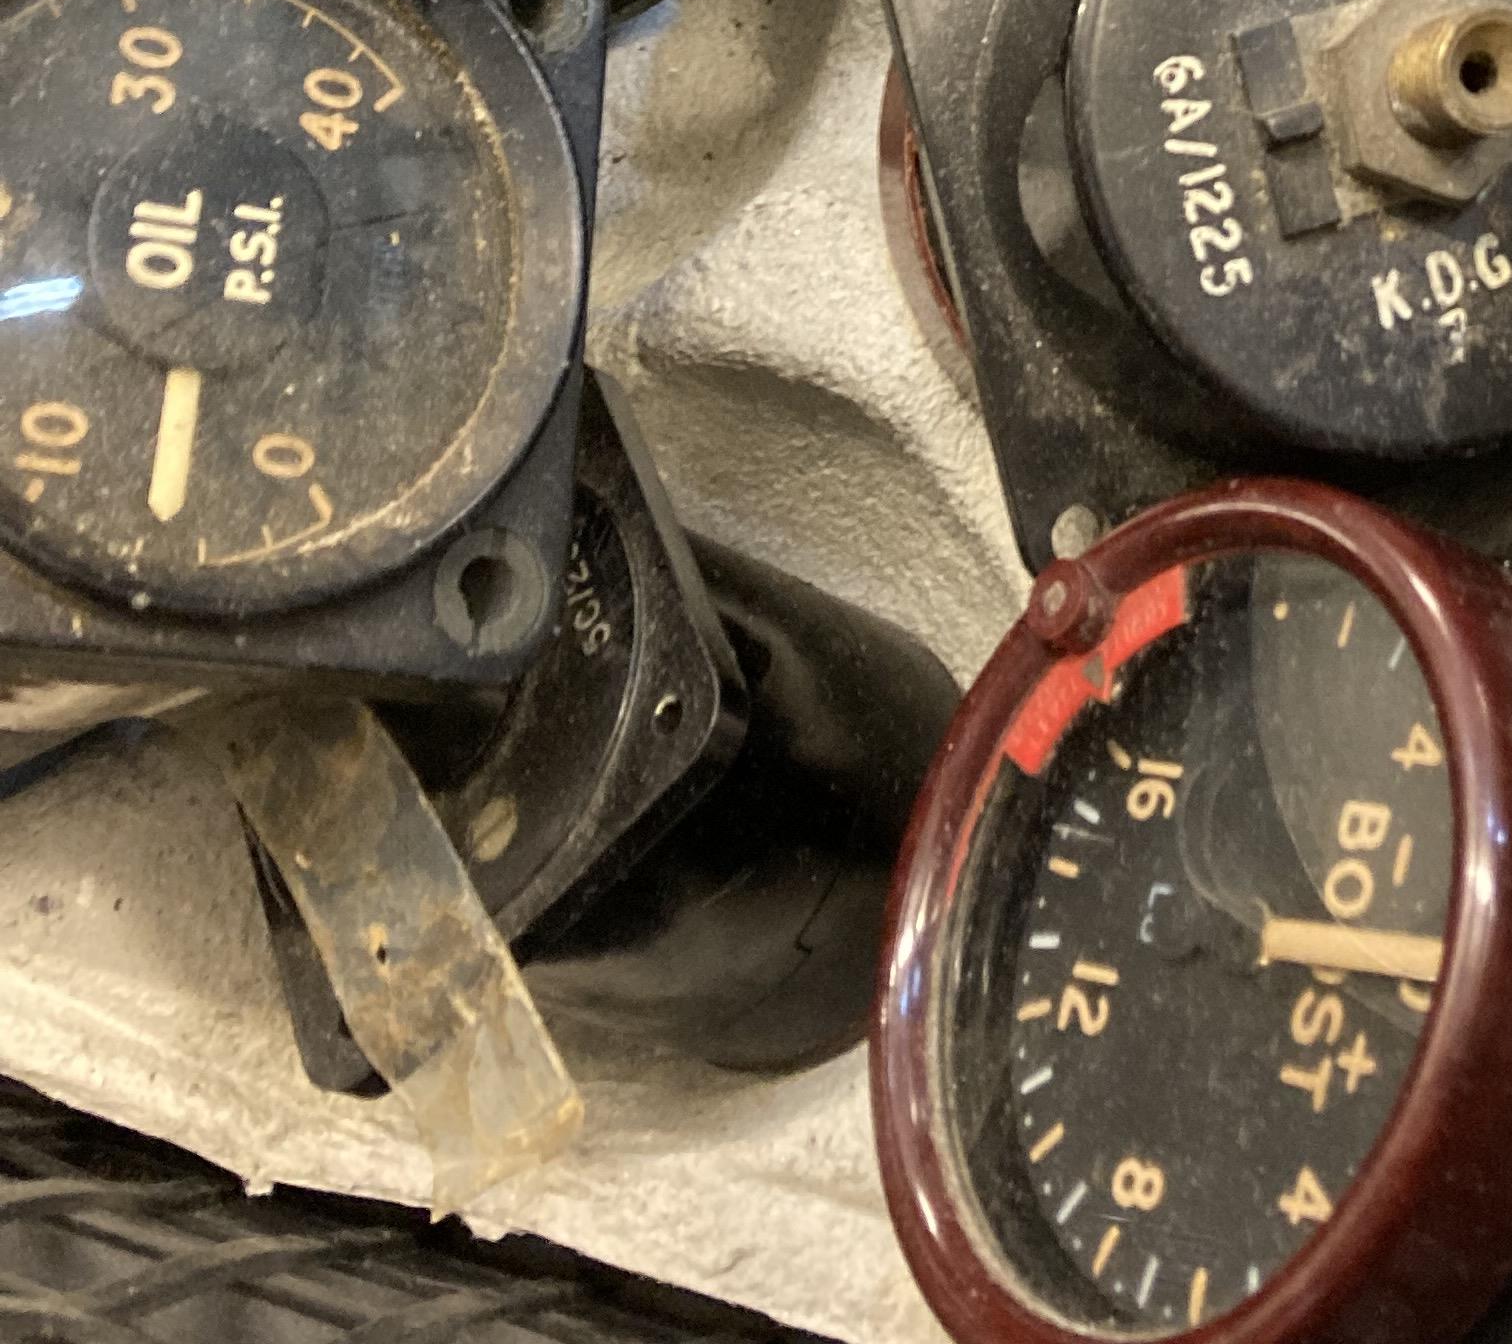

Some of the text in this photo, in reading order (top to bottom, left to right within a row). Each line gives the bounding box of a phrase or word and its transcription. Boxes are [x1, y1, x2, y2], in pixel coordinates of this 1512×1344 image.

[108, 25, 183, 115] 30
[299, 66, 364, 152] 40
[1151, 53, 1254, 298] 6A/1225
[125, 188, 204, 290] OIL
[223, 194, 286, 305] P.S.I.
[251, 431, 316, 479] 0
[1390, 721, 1445, 771] 4
[1125, 758, 1185, 824] 16
[1279, 798, 1393, 1115] BOST
[1055, 961, 1122, 1039] 12
[1110, 1155, 1167, 1212] 8
[1278, 1164, 1335, 1226] 4
